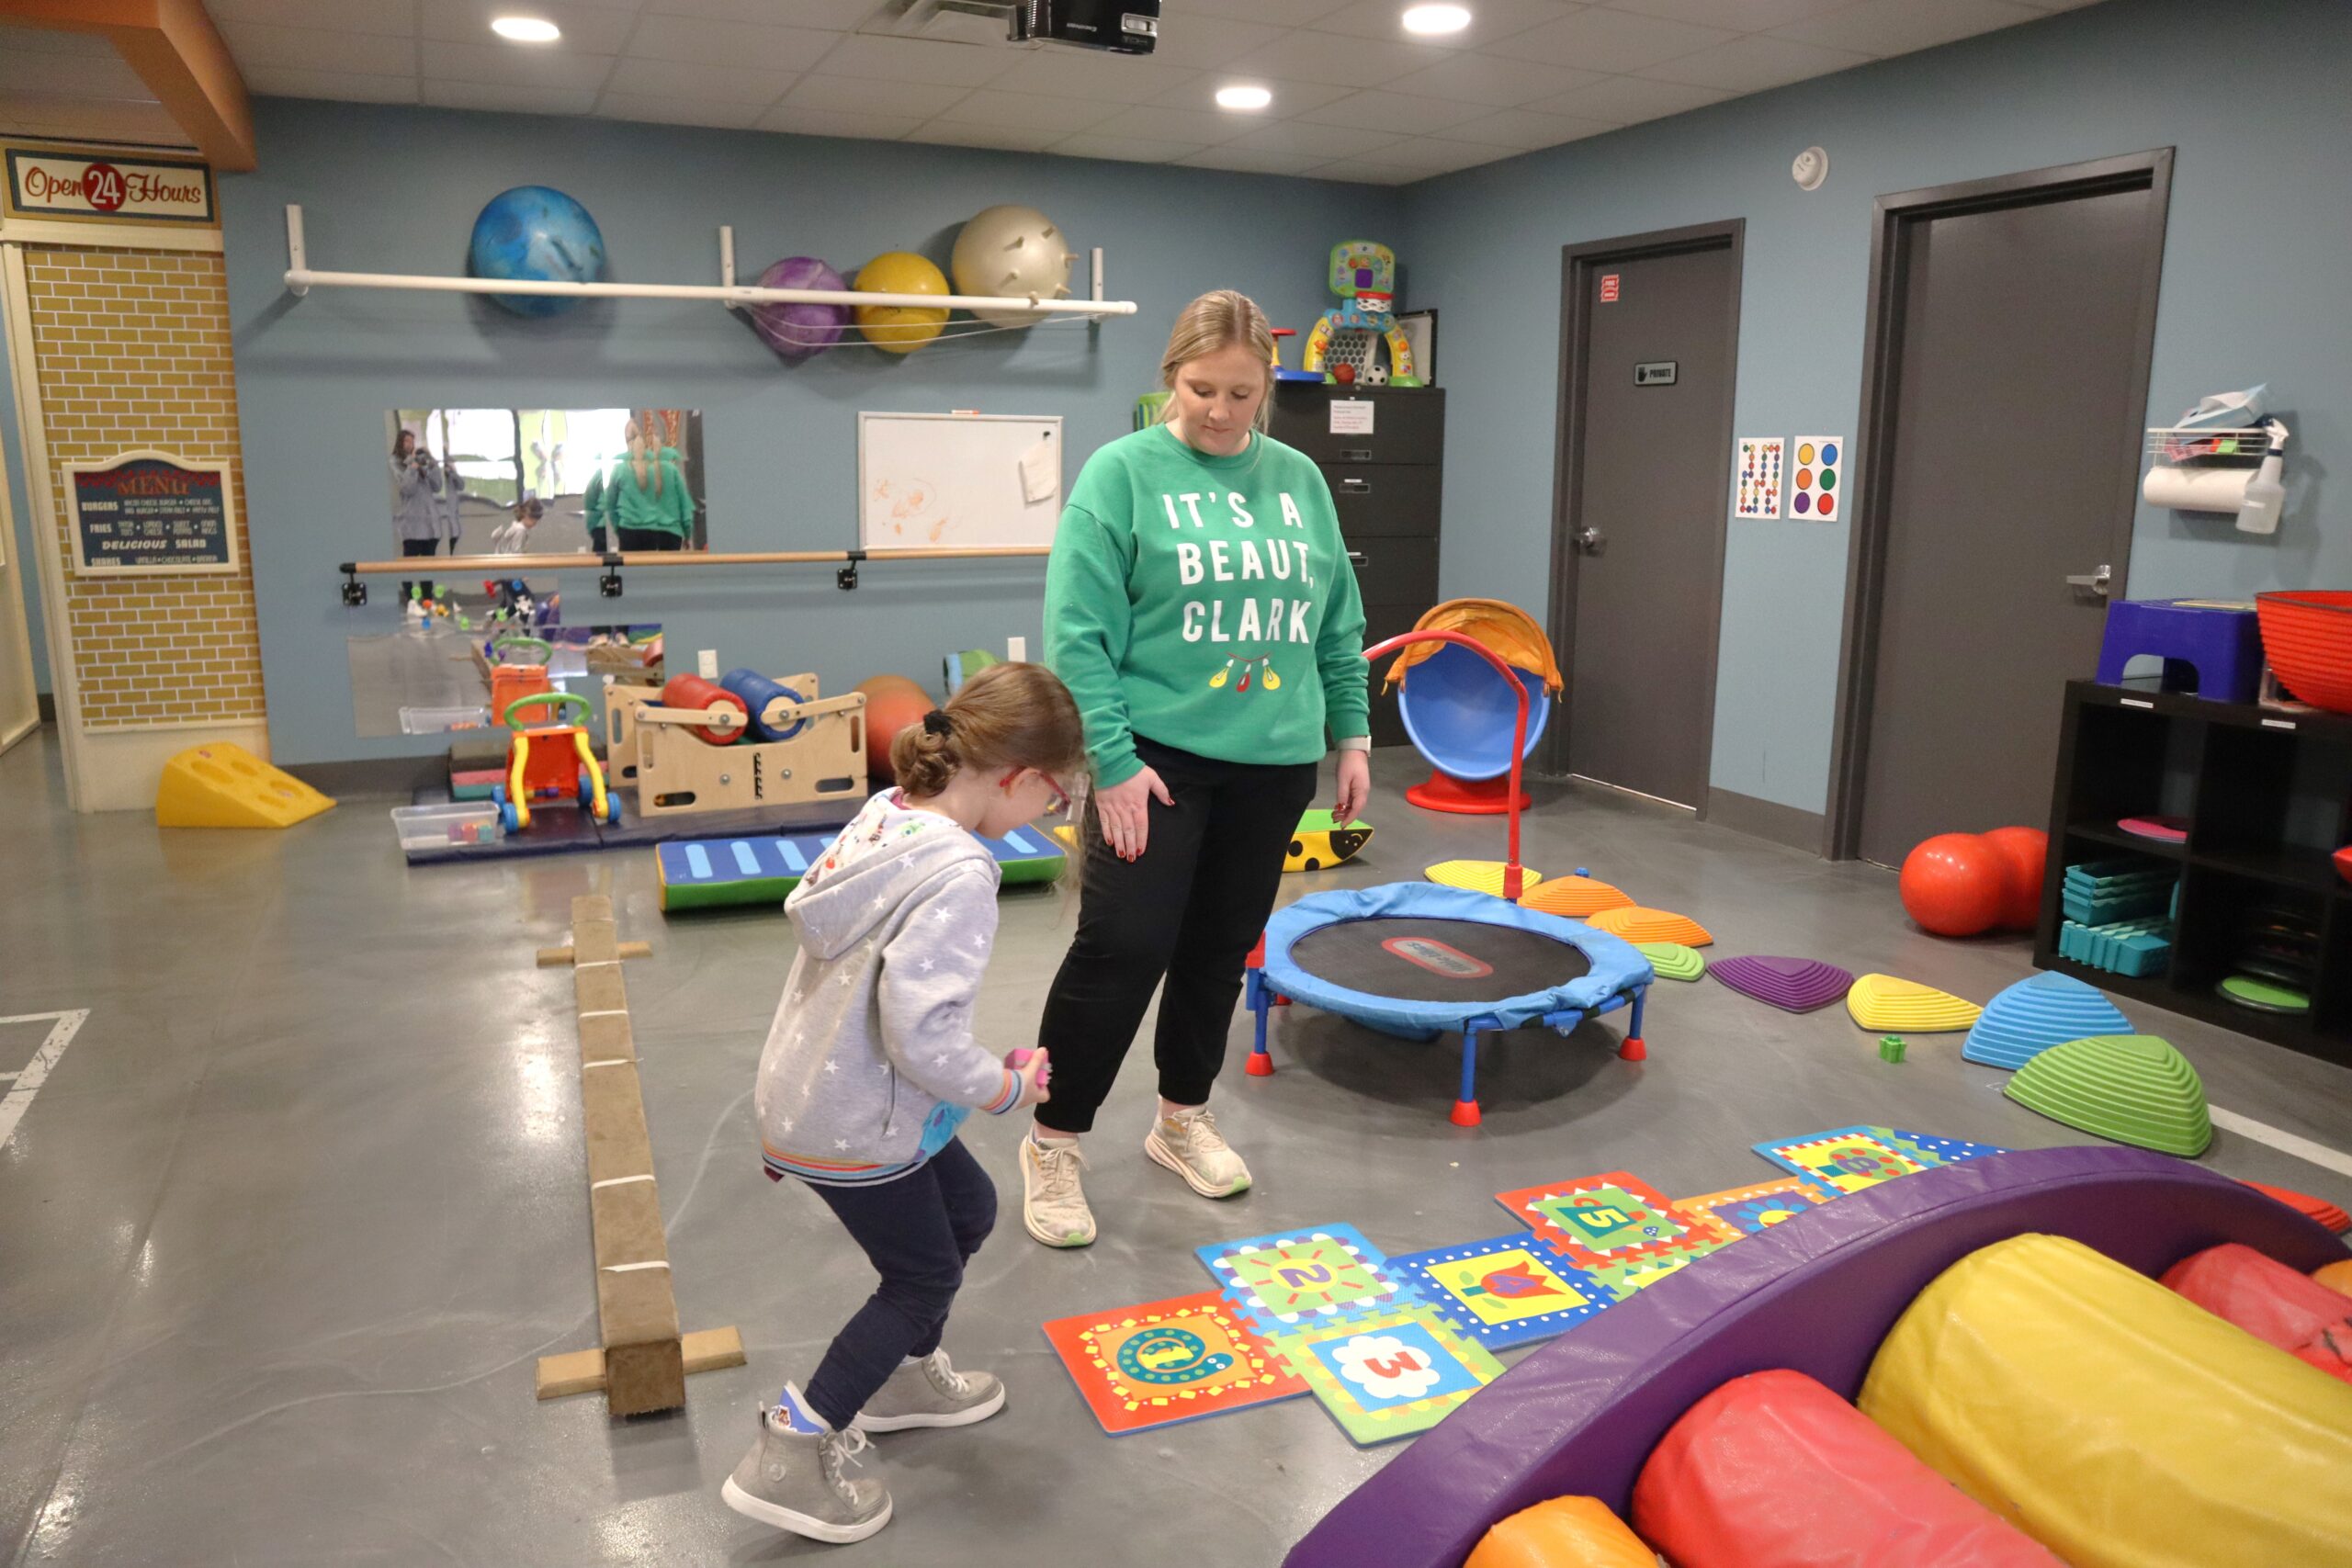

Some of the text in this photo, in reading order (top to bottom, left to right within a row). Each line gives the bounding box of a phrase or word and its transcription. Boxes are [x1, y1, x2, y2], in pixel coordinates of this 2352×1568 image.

[25, 165, 201, 205] Open 24 Hours
[1649, 368, 1671, 378] PRIVATE
[118, 475, 190, 495] MENU
[81, 501, 119, 512] BURGERS
[1162, 492, 1304, 529] IT'S A
[89, 523, 112, 534] FRIES
[102, 538, 207, 550] DELICIOUS SALAD
[1176, 538, 1315, 589] BEAUT,
[1182, 598, 1312, 644] CLARK
[1837, 1156, 1882, 1174] 8
[1577, 1208, 1630, 1228] 5
[1277, 1264, 1333, 1288] 2
[1488, 1274, 1537, 1295] 4
[1140, 1345, 1194, 1369] 1
[1363, 1350, 1423, 1379] 3
